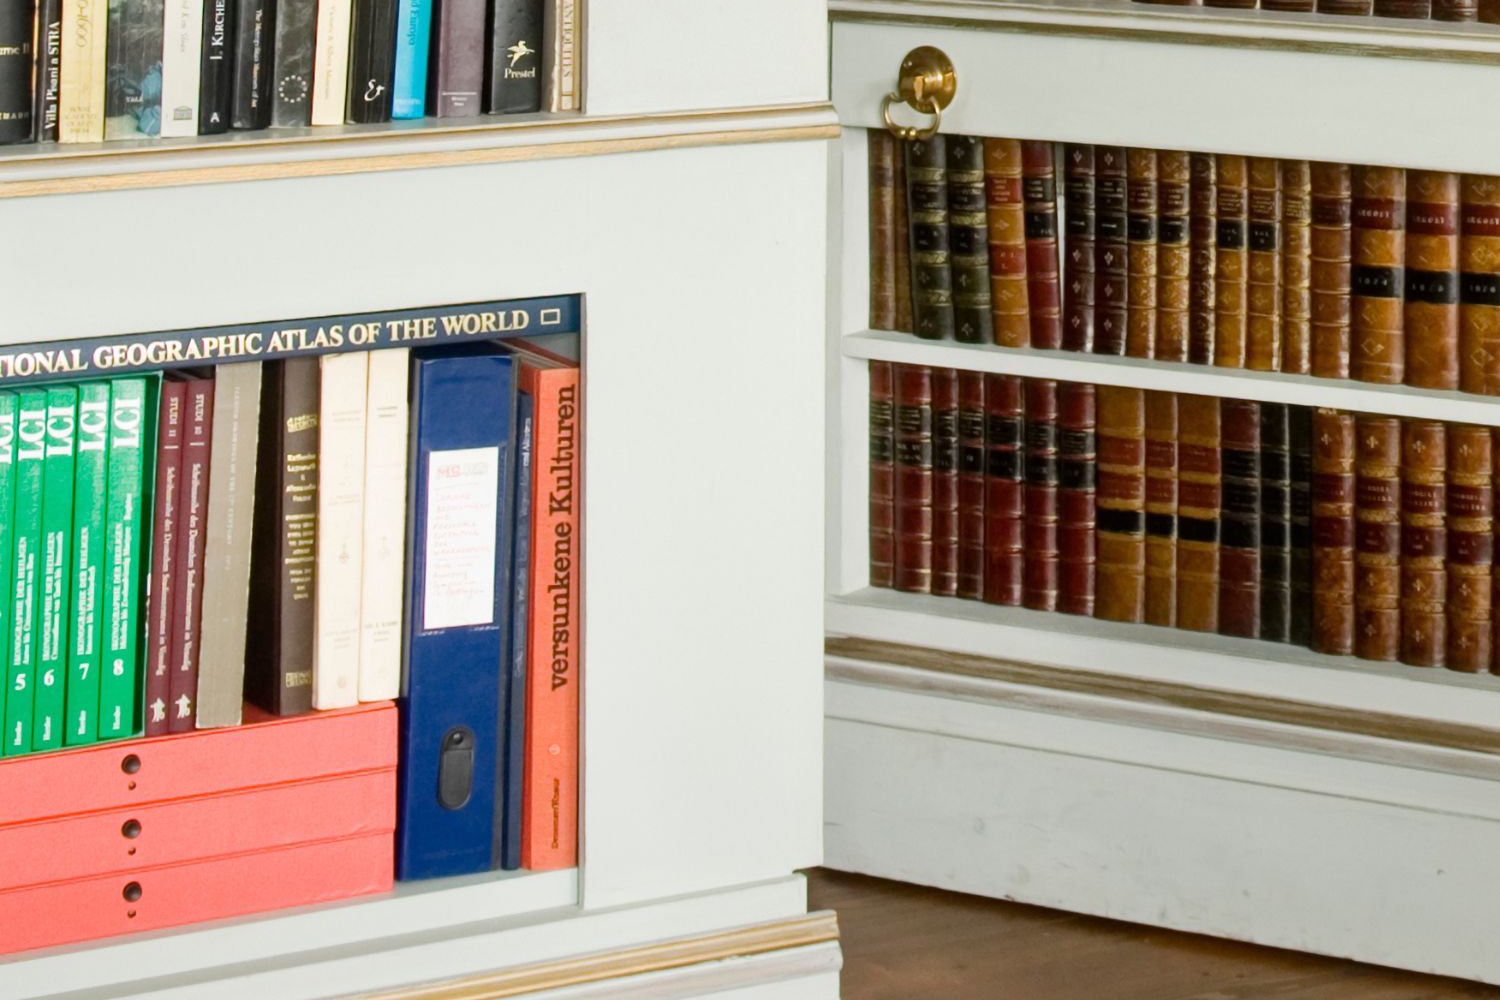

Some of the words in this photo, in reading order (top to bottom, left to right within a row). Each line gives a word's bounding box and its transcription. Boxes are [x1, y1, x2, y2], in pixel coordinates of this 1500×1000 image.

[48, 21, 61, 55] STRA
[504, 67, 536, 79] Prestel
[44, 103, 58, 129] Villa
[92, 332, 264, 368] GEOGRAPHIC
[266, 327, 344, 354] ATLAS
[349, 322, 381, 344] OF
[386, 317, 438, 342] THE
[441, 309, 531, 336] WORLD
[169, 396, 179, 425] STUDI
[194, 394, 205, 422] STUDI
[549, 383, 577, 520] Kulturen
[548, 522, 573, 692] versunkene
[43, 669, 55, 686] 6
[78, 662, 90, 680] 7
[112, 658, 124, 677] 8
[14, 673, 26, 691] 5
